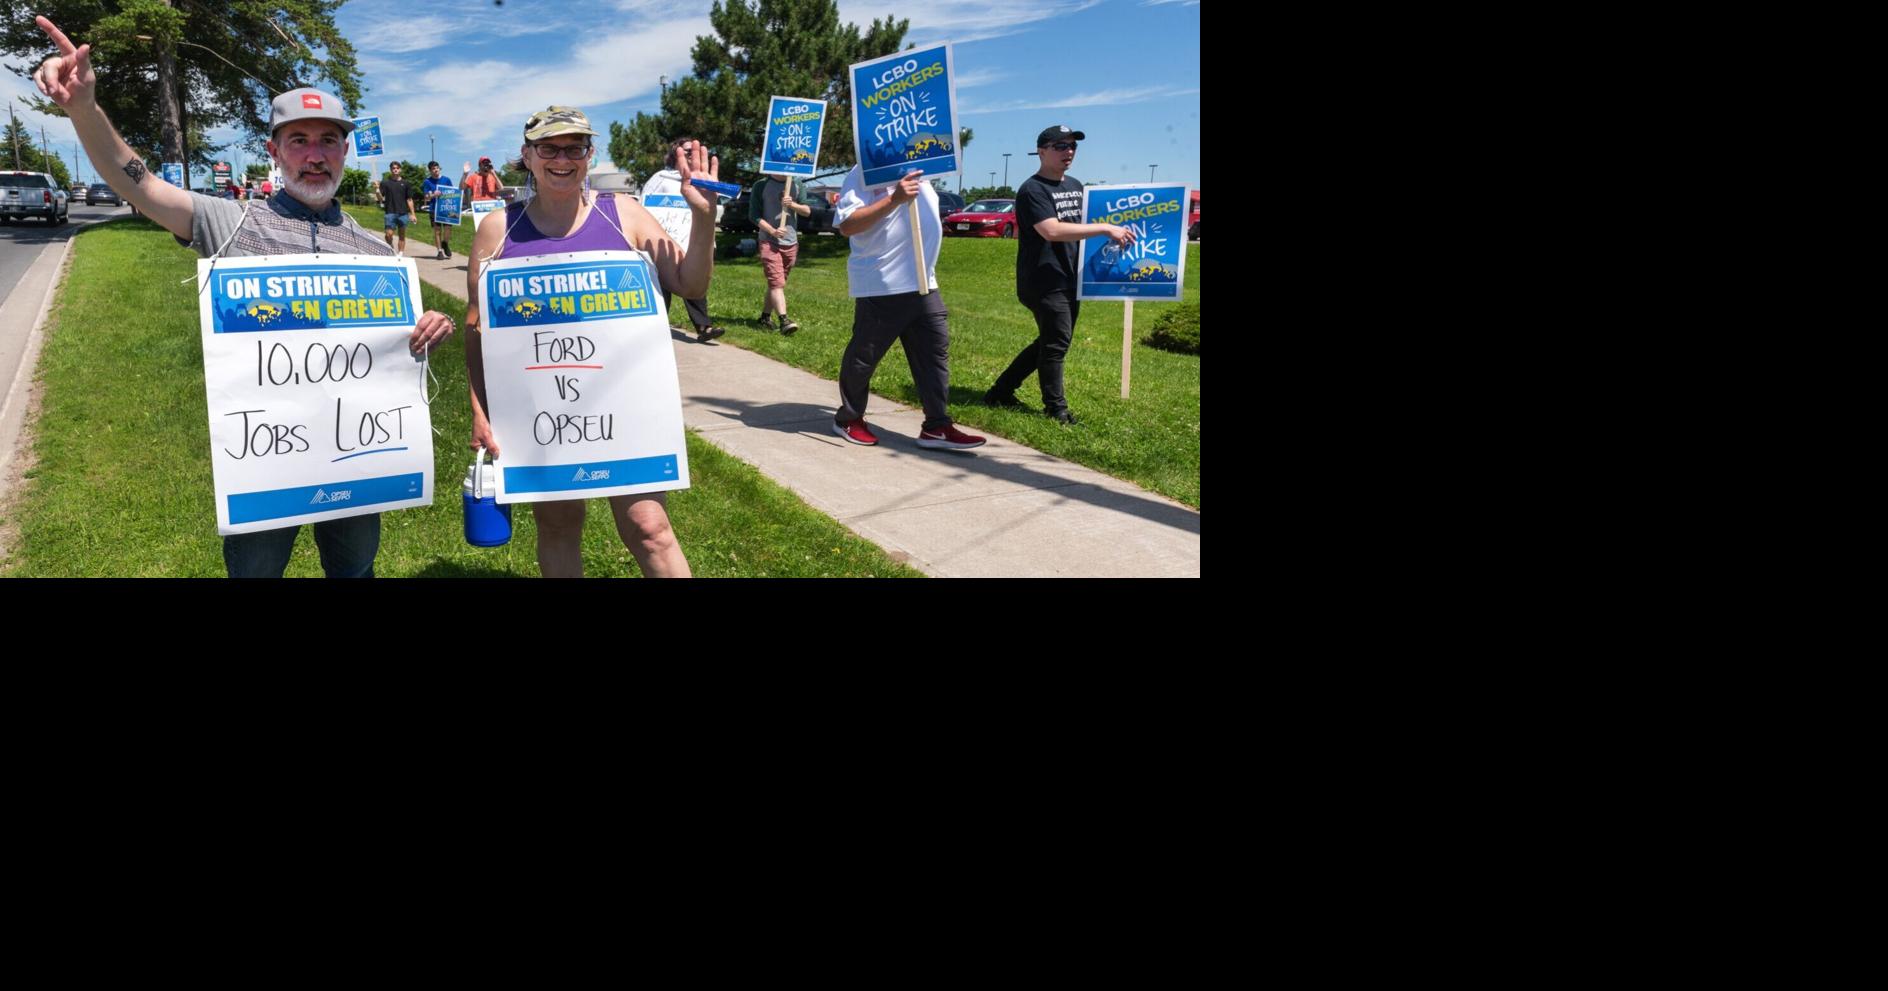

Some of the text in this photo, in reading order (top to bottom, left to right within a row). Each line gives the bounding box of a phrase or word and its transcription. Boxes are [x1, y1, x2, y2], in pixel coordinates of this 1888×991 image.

[861, 62, 945, 109] WORKERS
[872, 59, 918, 90] LCBO
[782, 104, 809, 116] LCBO
[889, 91, 917, 118] ON
[773, 112, 821, 126] WORKERS
[788, 122, 804, 136] ON
[873, 106, 938, 146] STRIKE
[776, 135, 812, 150] STRIKE
[1106, 192, 1155, 213] LCBO
[226, 274, 358, 300] ON STRIKE!
[498, 269, 608, 298] ON STRIKE!
[291, 294, 403, 320] EN GRÈVE!
[549, 287, 647, 315] EN GRÈVE!
[533, 330, 596, 363] FORD
[257, 340, 373, 386] 10,000
[224, 397, 412, 460] JOBS LOST
[533, 410, 614, 446] OPSEU
